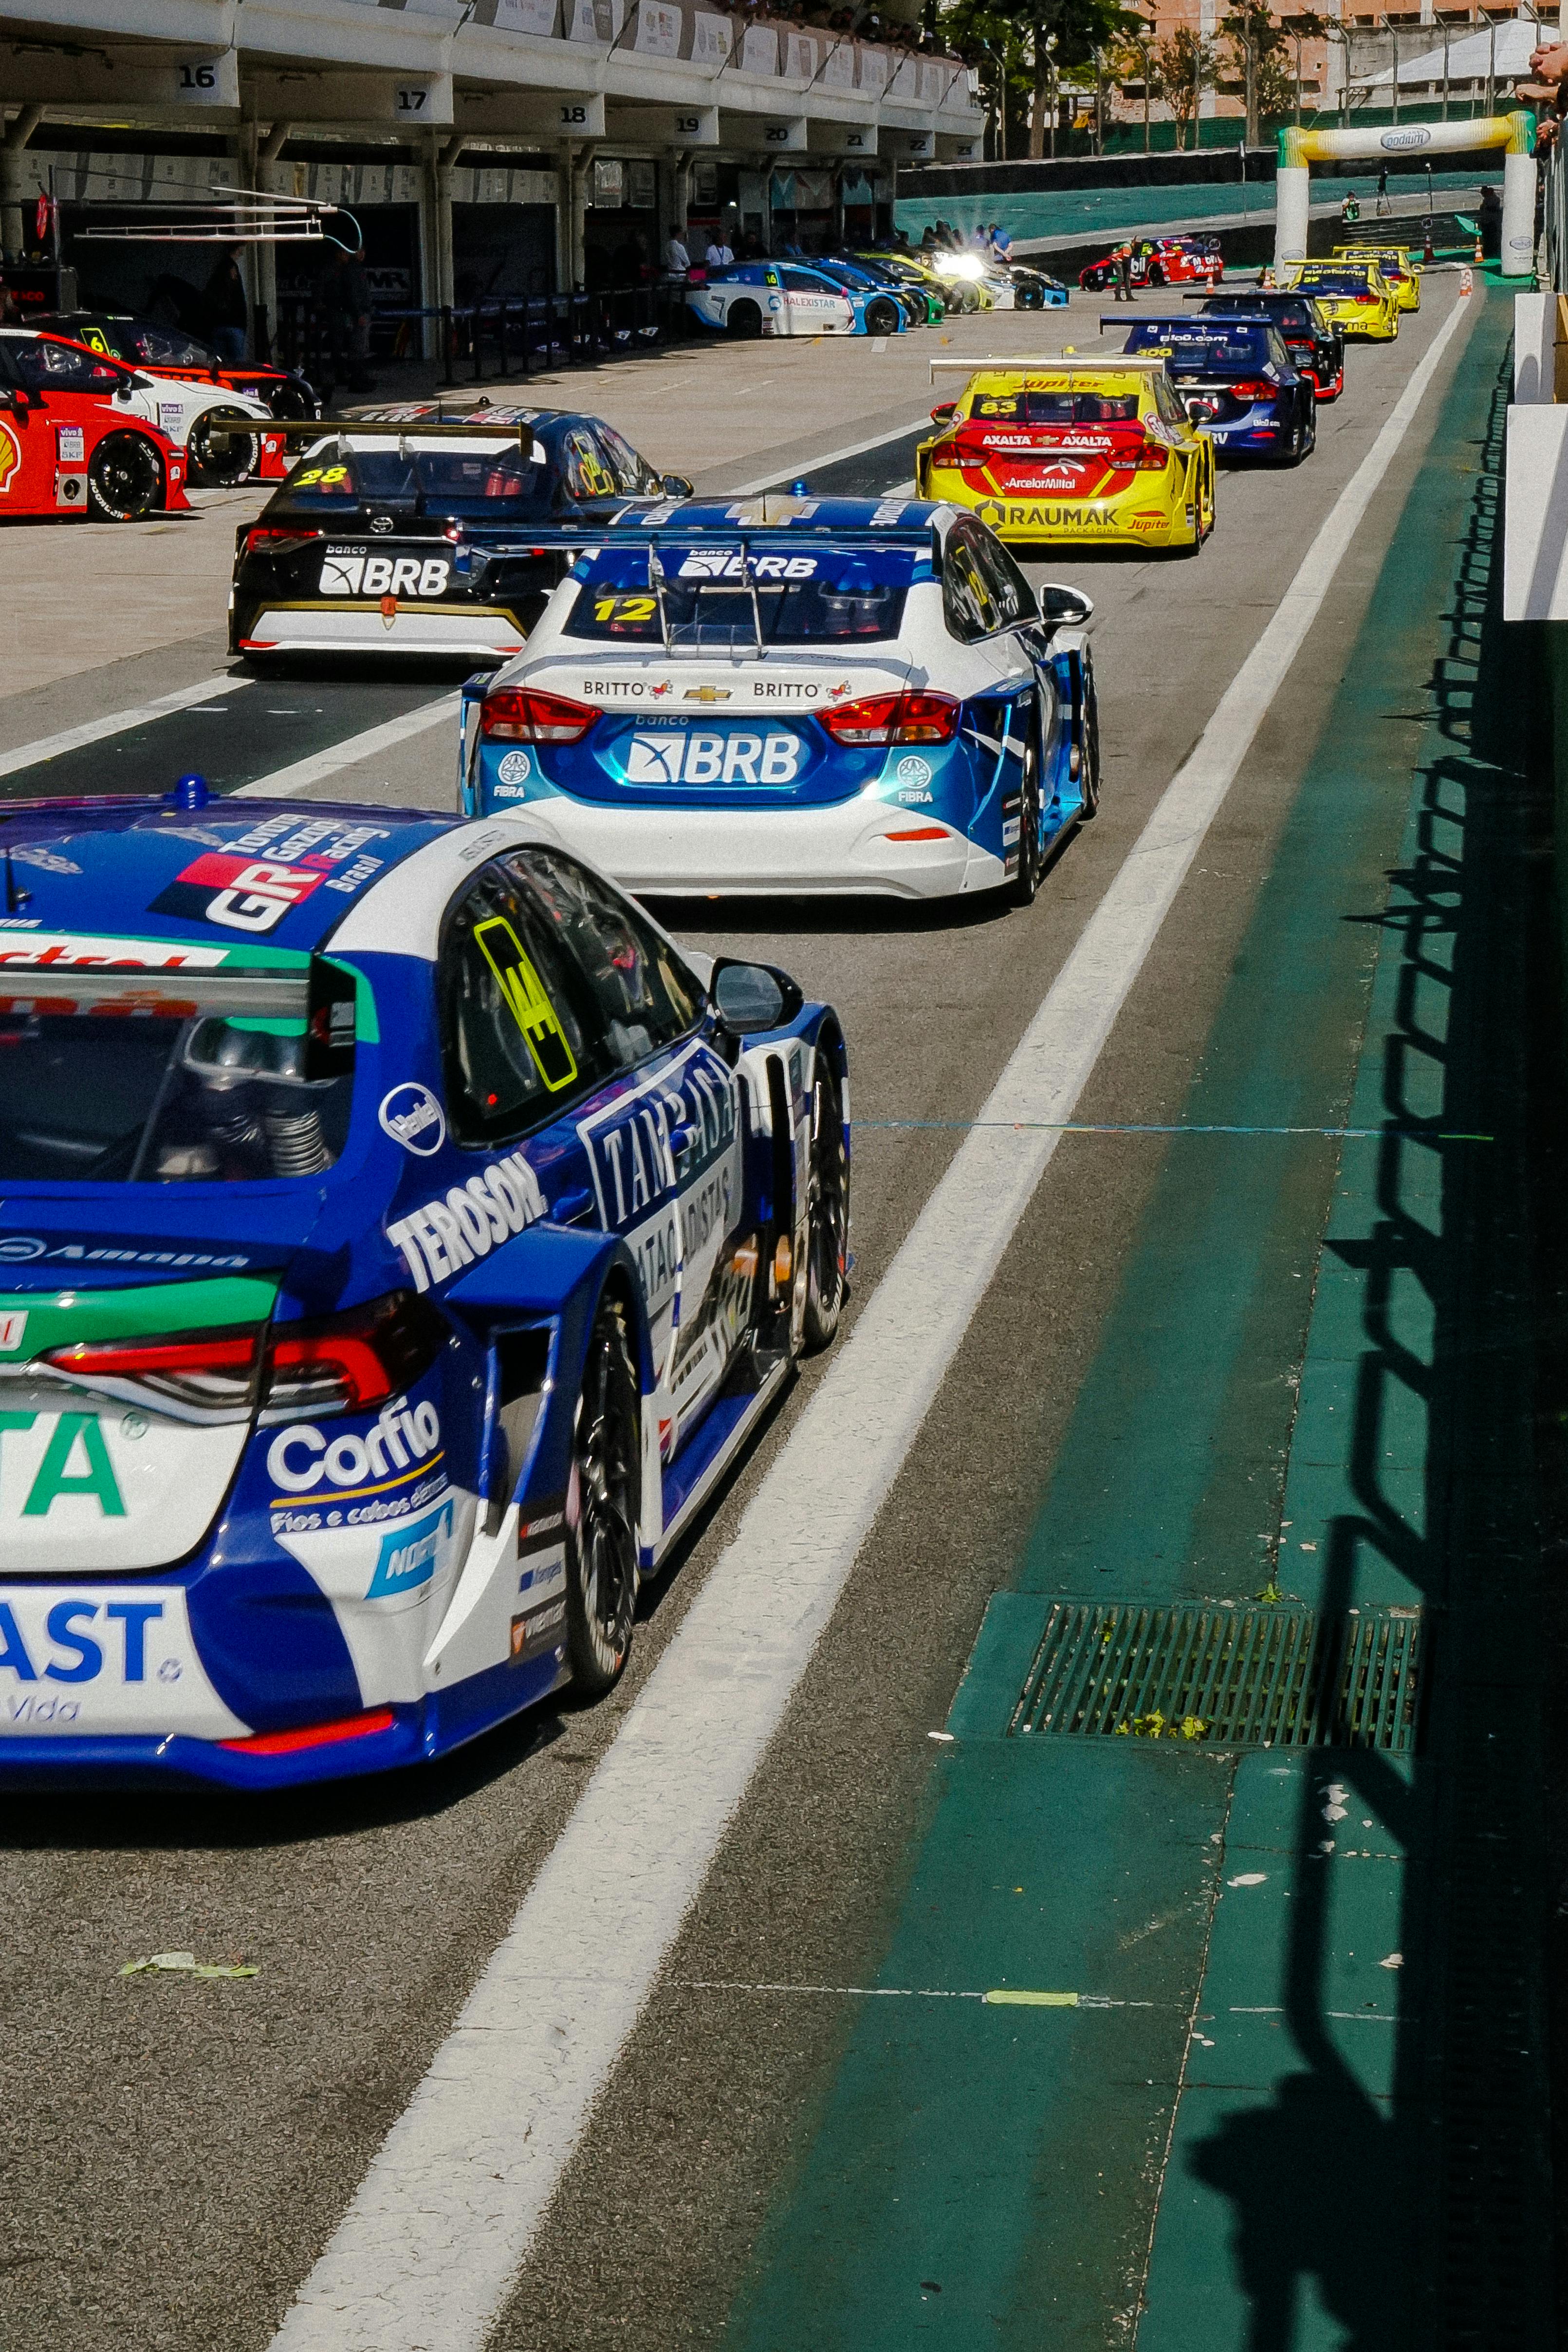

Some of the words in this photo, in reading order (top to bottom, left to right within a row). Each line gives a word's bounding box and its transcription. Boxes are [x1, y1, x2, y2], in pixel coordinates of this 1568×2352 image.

[180, 65, 215, 88] 16
[398, 91, 426, 110] 17
[561, 106, 586, 123] 18
[676, 117, 699, 132] 19
[766, 128, 788, 141] 20
[848, 135, 864, 146] 21
[766, 274, 777, 284] 16
[980, 401, 1017, 414] 83
[60, 428, 77, 437] vivo
[982, 435, 1032, 445] AXALTA
[1061, 436, 1113, 446] AXALTA
[294, 466, 348, 486] 28
[1008, 478, 1075, 490] ArcelorMittal
[1010, 506, 1120, 526] RAUMAK
[326, 545, 367, 555] banco
[723, 556, 818, 578] BRB
[362, 557, 451, 596] BRB
[594, 597, 656, 621] 12
[584, 682, 644, 696] BRITTO
[754, 683, 818, 698] BRITTO
[635, 715, 689, 726] banco
[683, 732, 800, 783] BRB
[494, 785, 525, 798] FIBRA
[898, 792, 933, 802] FIBRA
[324, 854, 385, 893] Brasil
[205, 862, 321, 932] GR
[389, 1152, 542, 1293] TEROSON
[267, 1395, 440, 1492] Corfio
[0, 1411, 128, 1517] A
[270, 1512, 322, 1534] Fios
[327, 1511, 342, 1526] e
